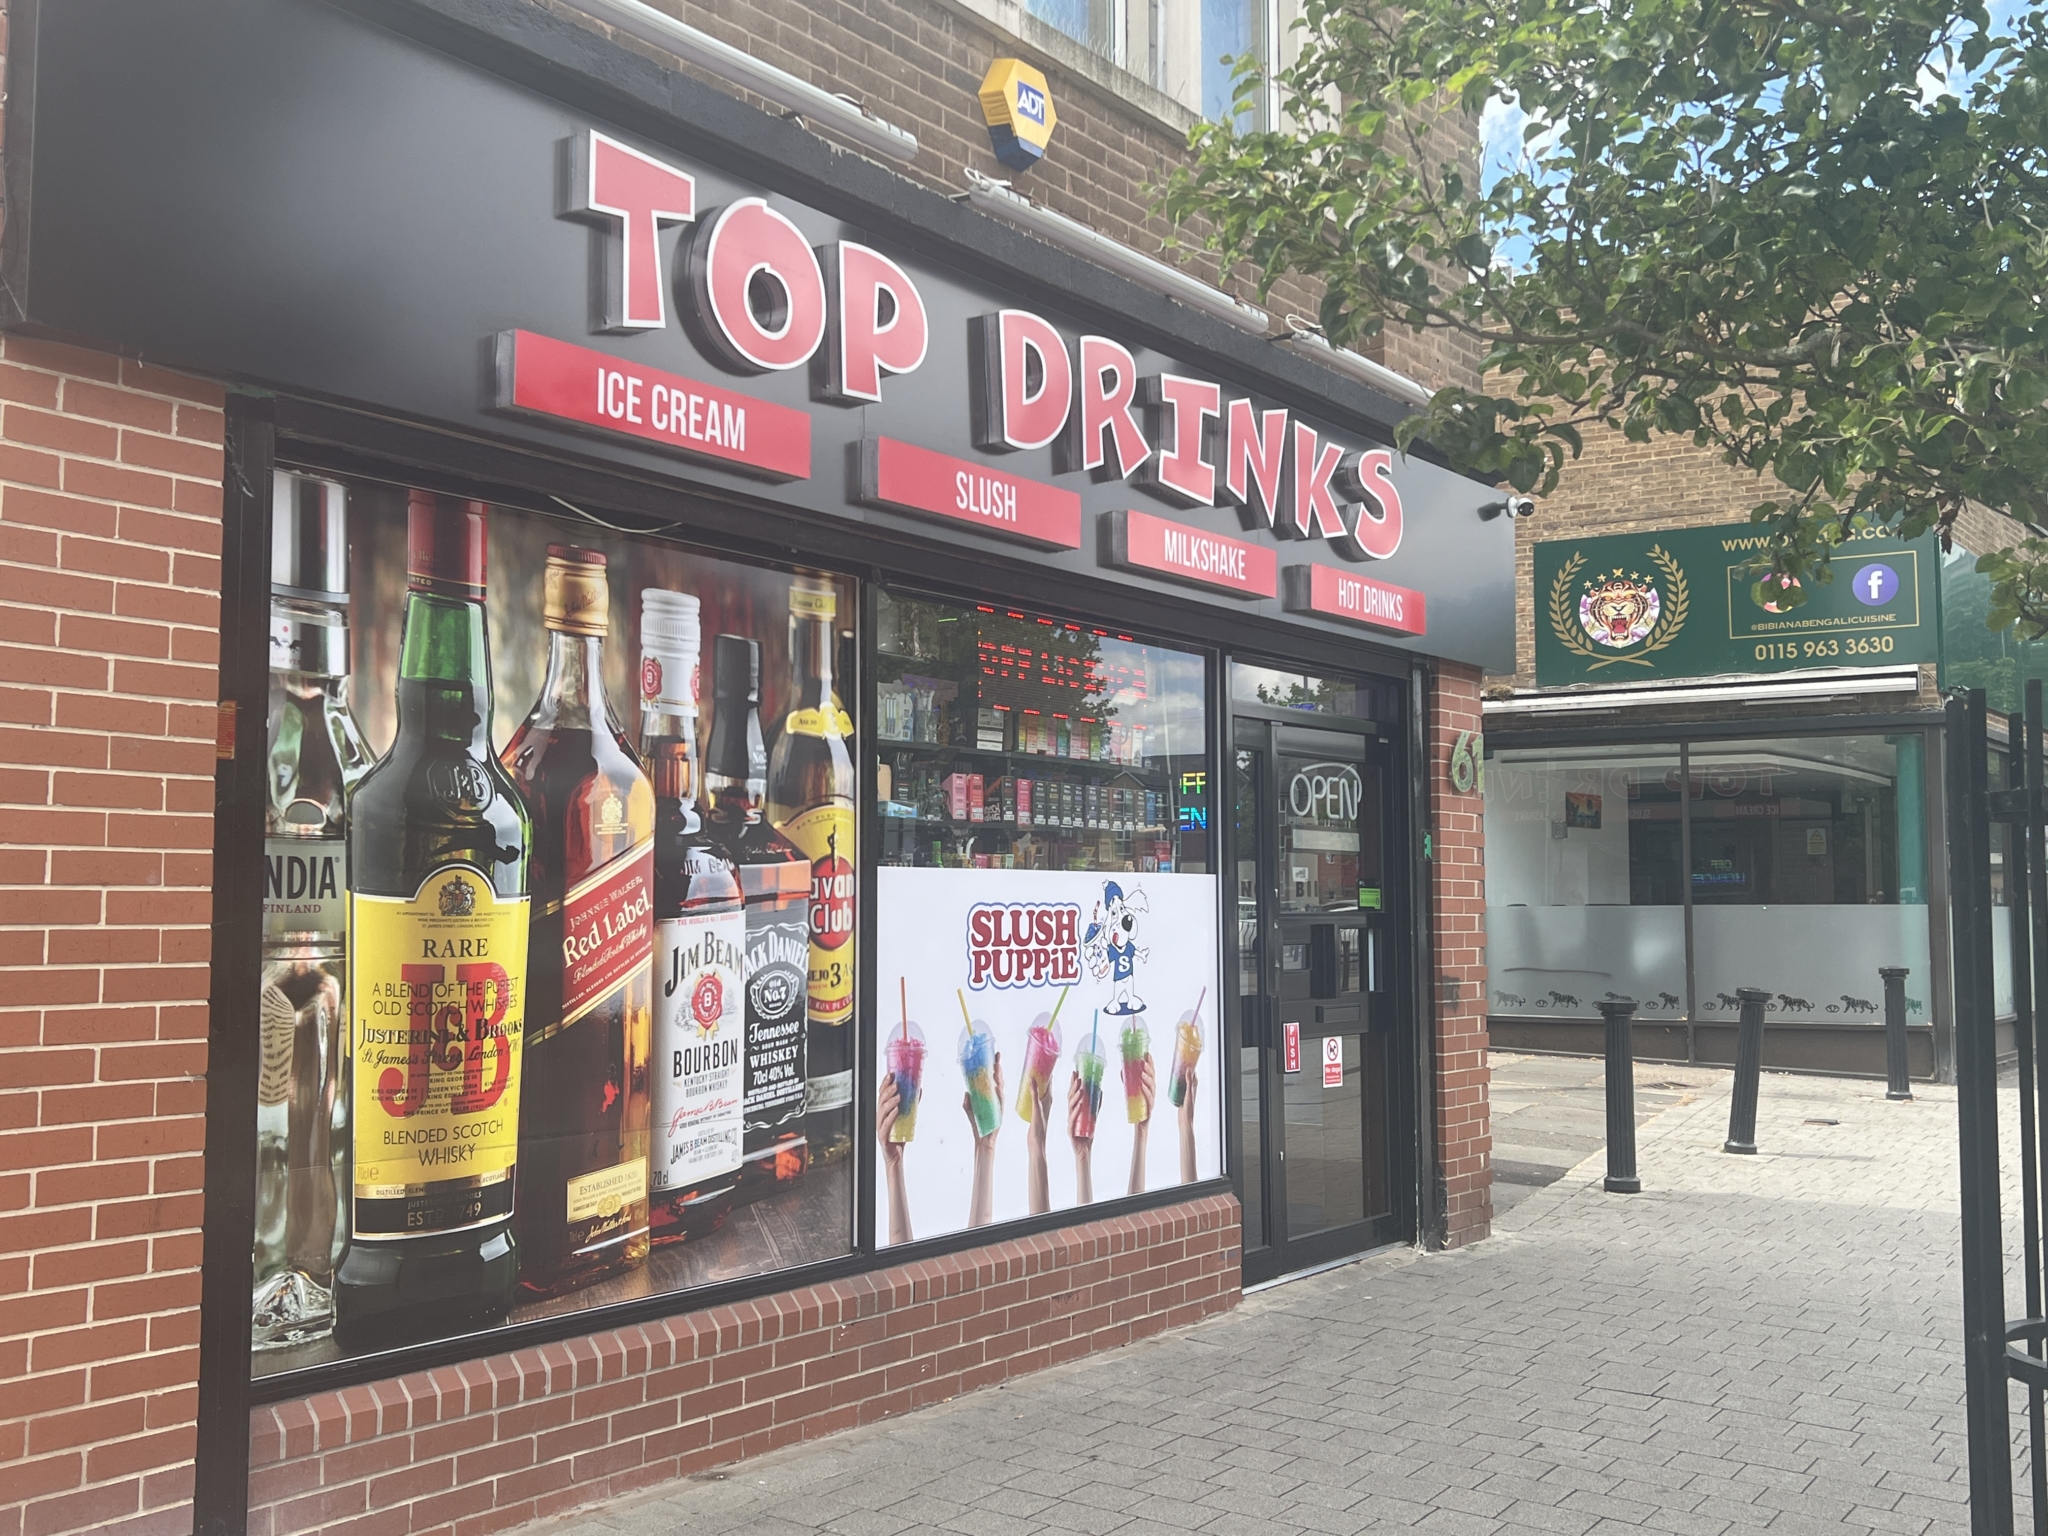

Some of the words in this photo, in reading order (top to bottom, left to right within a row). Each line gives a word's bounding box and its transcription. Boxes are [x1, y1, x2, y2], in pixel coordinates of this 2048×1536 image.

[1018, 88, 1045, 120] ADT
[588, 128, 929, 403] TOP
[999, 308, 1404, 560] DRINKS
[597, 367, 643, 425] ICE
[651, 383, 746, 452] CREAM
[955, 471, 1017, 522] SLUSH
[1164, 528, 1247, 581] MILKSHAKE
[1338, 578, 1361, 608] HOT
[1363, 586, 1403, 622] DRINKS
[1751, 613, 1897, 631] @BIBIANABENGALICUISINE
[1755, 642, 1798, 661] 0115
[1803, 639, 1840, 658] 963
[1845, 635, 1894, 654] 3630
[1452, 731, 1485, 793] 61
[1290, 772, 1358, 822] OPEN
[262, 903, 322, 914] FINLAND
[570, 899, 610, 932] JOHNNIE
[608, 876, 641, 903] WALKER
[562, 921, 604, 969] Red
[602, 886, 653, 940] Label
[809, 900, 853, 935] Club
[971, 909, 1078, 948] SLUSH
[421, 938, 489, 959] RARE
[664, 942, 701, 998] JIM
[703, 931, 744, 982] BEAM
[830, 962, 842, 988] 3
[972, 947, 1079, 984] PUPPiE
[1118, 954, 1131, 973] S
[372, 982, 383, 997] A
[385, 983, 430, 998] BLEND
[434, 983, 455, 998] OF
[457, 982, 483, 997] THE
[485, 977, 519, 995] PUREST
[764, 985, 787, 1004] No.7
[769, 978, 782, 988] Old
[372, 1001, 402, 1016] OLD
[406, 1001, 468, 1017] SCOTCH
[703, 992, 712, 1008] B
[376, 961, 511, 1121] J&B
[455, 1022, 471, 1043] &
[475, 1018, 523, 1041] BROOKS
[749, 1020, 800, 1044] Tennessee
[373, 1049, 419, 1069] James's
[466, 1045, 505, 1062] London
[673, 1038, 738, 1079] BOURBON
[750, 1045, 799, 1069] WHISKEY
[1289, 1025, 1297, 1069] PUSH
[446, 1075, 469, 1083] GEORGE
[683, 1072, 708, 1088] KENTUCKY
[708, 1068, 730, 1083] STRAIGHT
[753, 1068, 768, 1086] 70cl
[768, 1065, 784, 1081] 40%
[428, 1085, 449, 1094] QUEEN
[450, 1083, 478, 1092] VICTORIA
[686, 1083, 708, 1098] BOURBON
[708, 1079, 728, 1093] WHISKEY
[416, 1108, 439, 1116] PRINCE
[383, 1127, 448, 1145] BLENDED
[452, 1118, 504, 1140] SCOTCH
[418, 1142, 477, 1167] WHISKY
[670, 1141, 690, 1165] JAMES
[694, 1135, 708, 1149] BEAM
[579, 1174, 624, 1196] ESTABLISHED
[652, 1170, 663, 1186] 70
[375, 1188, 405, 1196] DISTILLED
